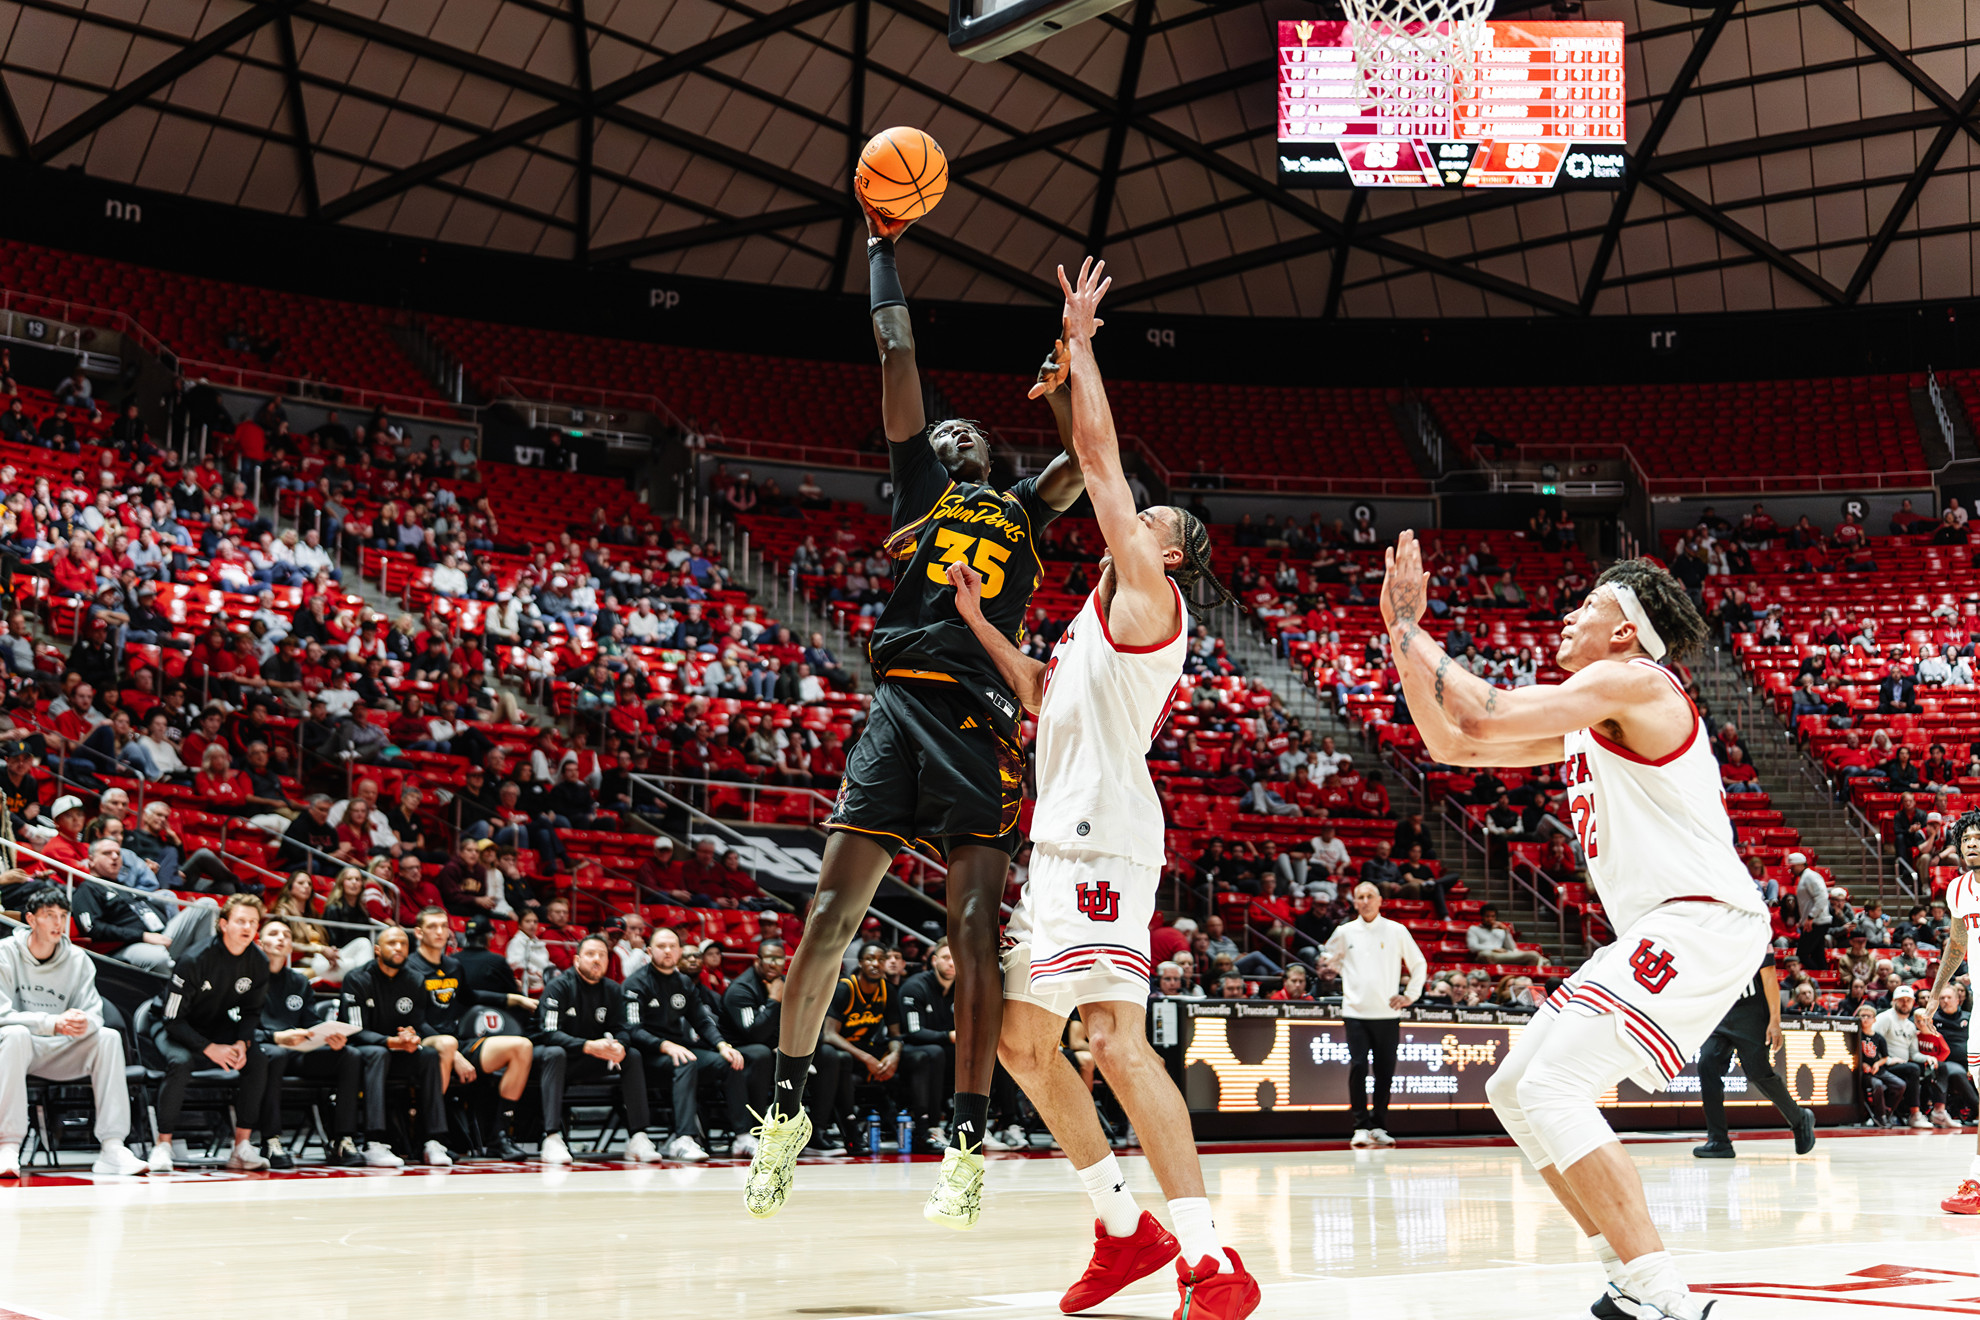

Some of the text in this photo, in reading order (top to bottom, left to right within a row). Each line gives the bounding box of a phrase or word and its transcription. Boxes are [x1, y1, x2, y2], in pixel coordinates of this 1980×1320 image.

[1364, 142, 1400, 168] 65
[1505, 143, 1541, 169] 56
[1593, 166, 1621, 178] Bank
[105, 199, 142, 223] nn
[650, 288, 680, 309] pp
[1146, 328, 1175, 348] qq
[1651, 330, 1677, 348] rr
[1847, 501, 1863, 518] R
[926, 526, 1012, 599] 35
[485, 1015, 498, 1029] U
